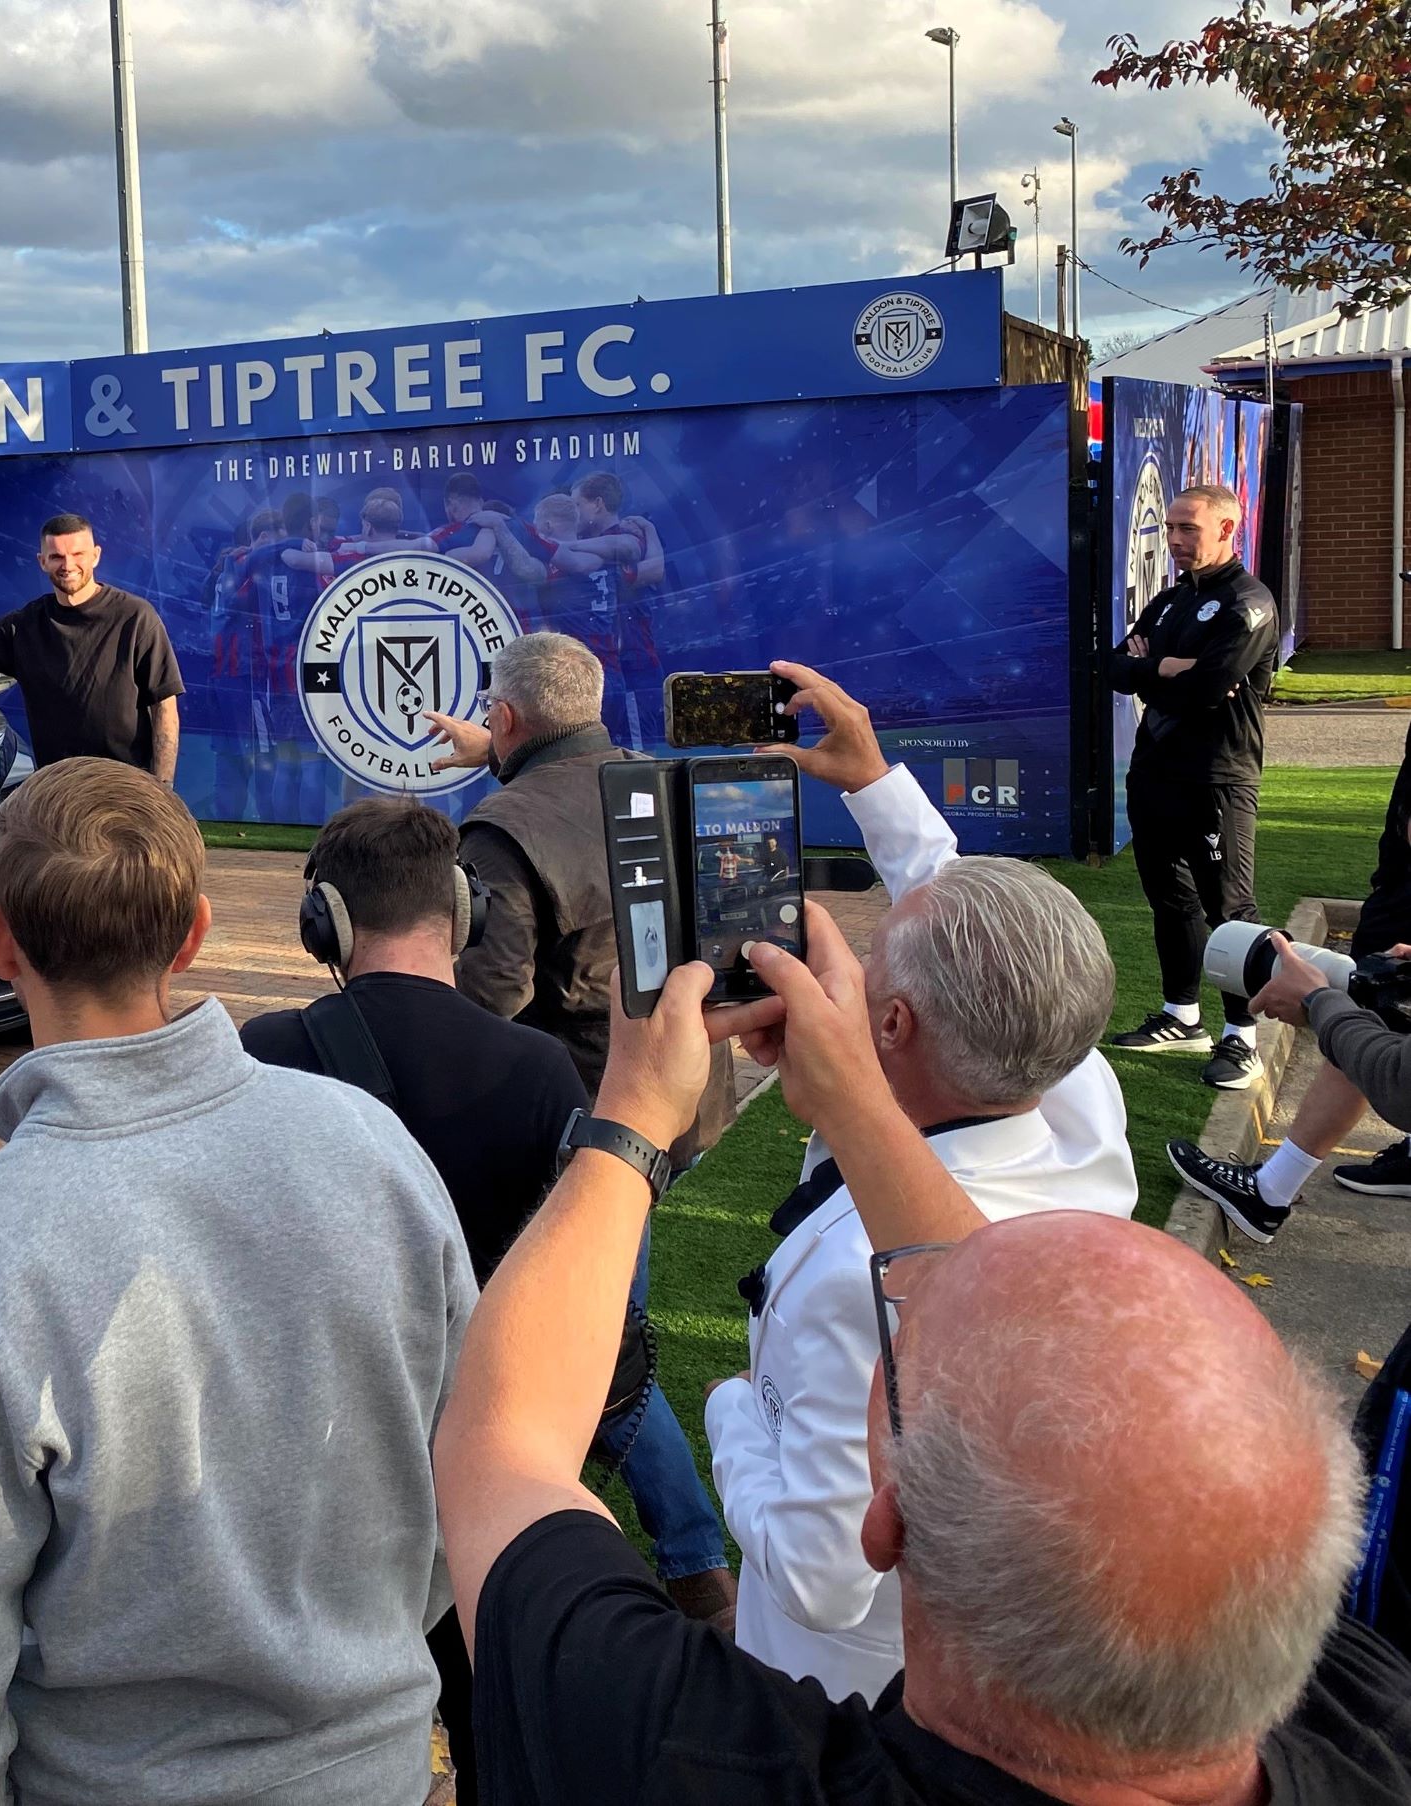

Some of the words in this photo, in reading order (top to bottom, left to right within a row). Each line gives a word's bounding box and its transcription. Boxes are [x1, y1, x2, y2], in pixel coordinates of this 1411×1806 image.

[861, 298, 894, 330] MALDON
[896, 297, 903, 305] &
[905, 298, 936, 326] TIPTREE
[865, 352, 910, 373] FOOTBALL
[913, 347, 933, 368] CLUB
[84, 374, 138, 438] &
[161, 338, 483, 430] TIPTREE
[525, 324, 671, 402] FC.
[214, 458, 254, 482] THE
[269, 441, 498, 479] DREWITT-BARLOW
[515, 431, 641, 464] STADIUM
[315, 570, 397, 653] MALDON
[402, 568, 419, 587] &
[426, 571, 505, 653] TIPTREE
[327, 714, 441, 778] FOOTBALL
[898, 739, 956, 748] SPONSORED
[957, 739, 970, 748] BY
[945, 783, 1018, 805] PCR
[703, 823, 722, 836] TO
[1209, 850, 1222, 861] LB
